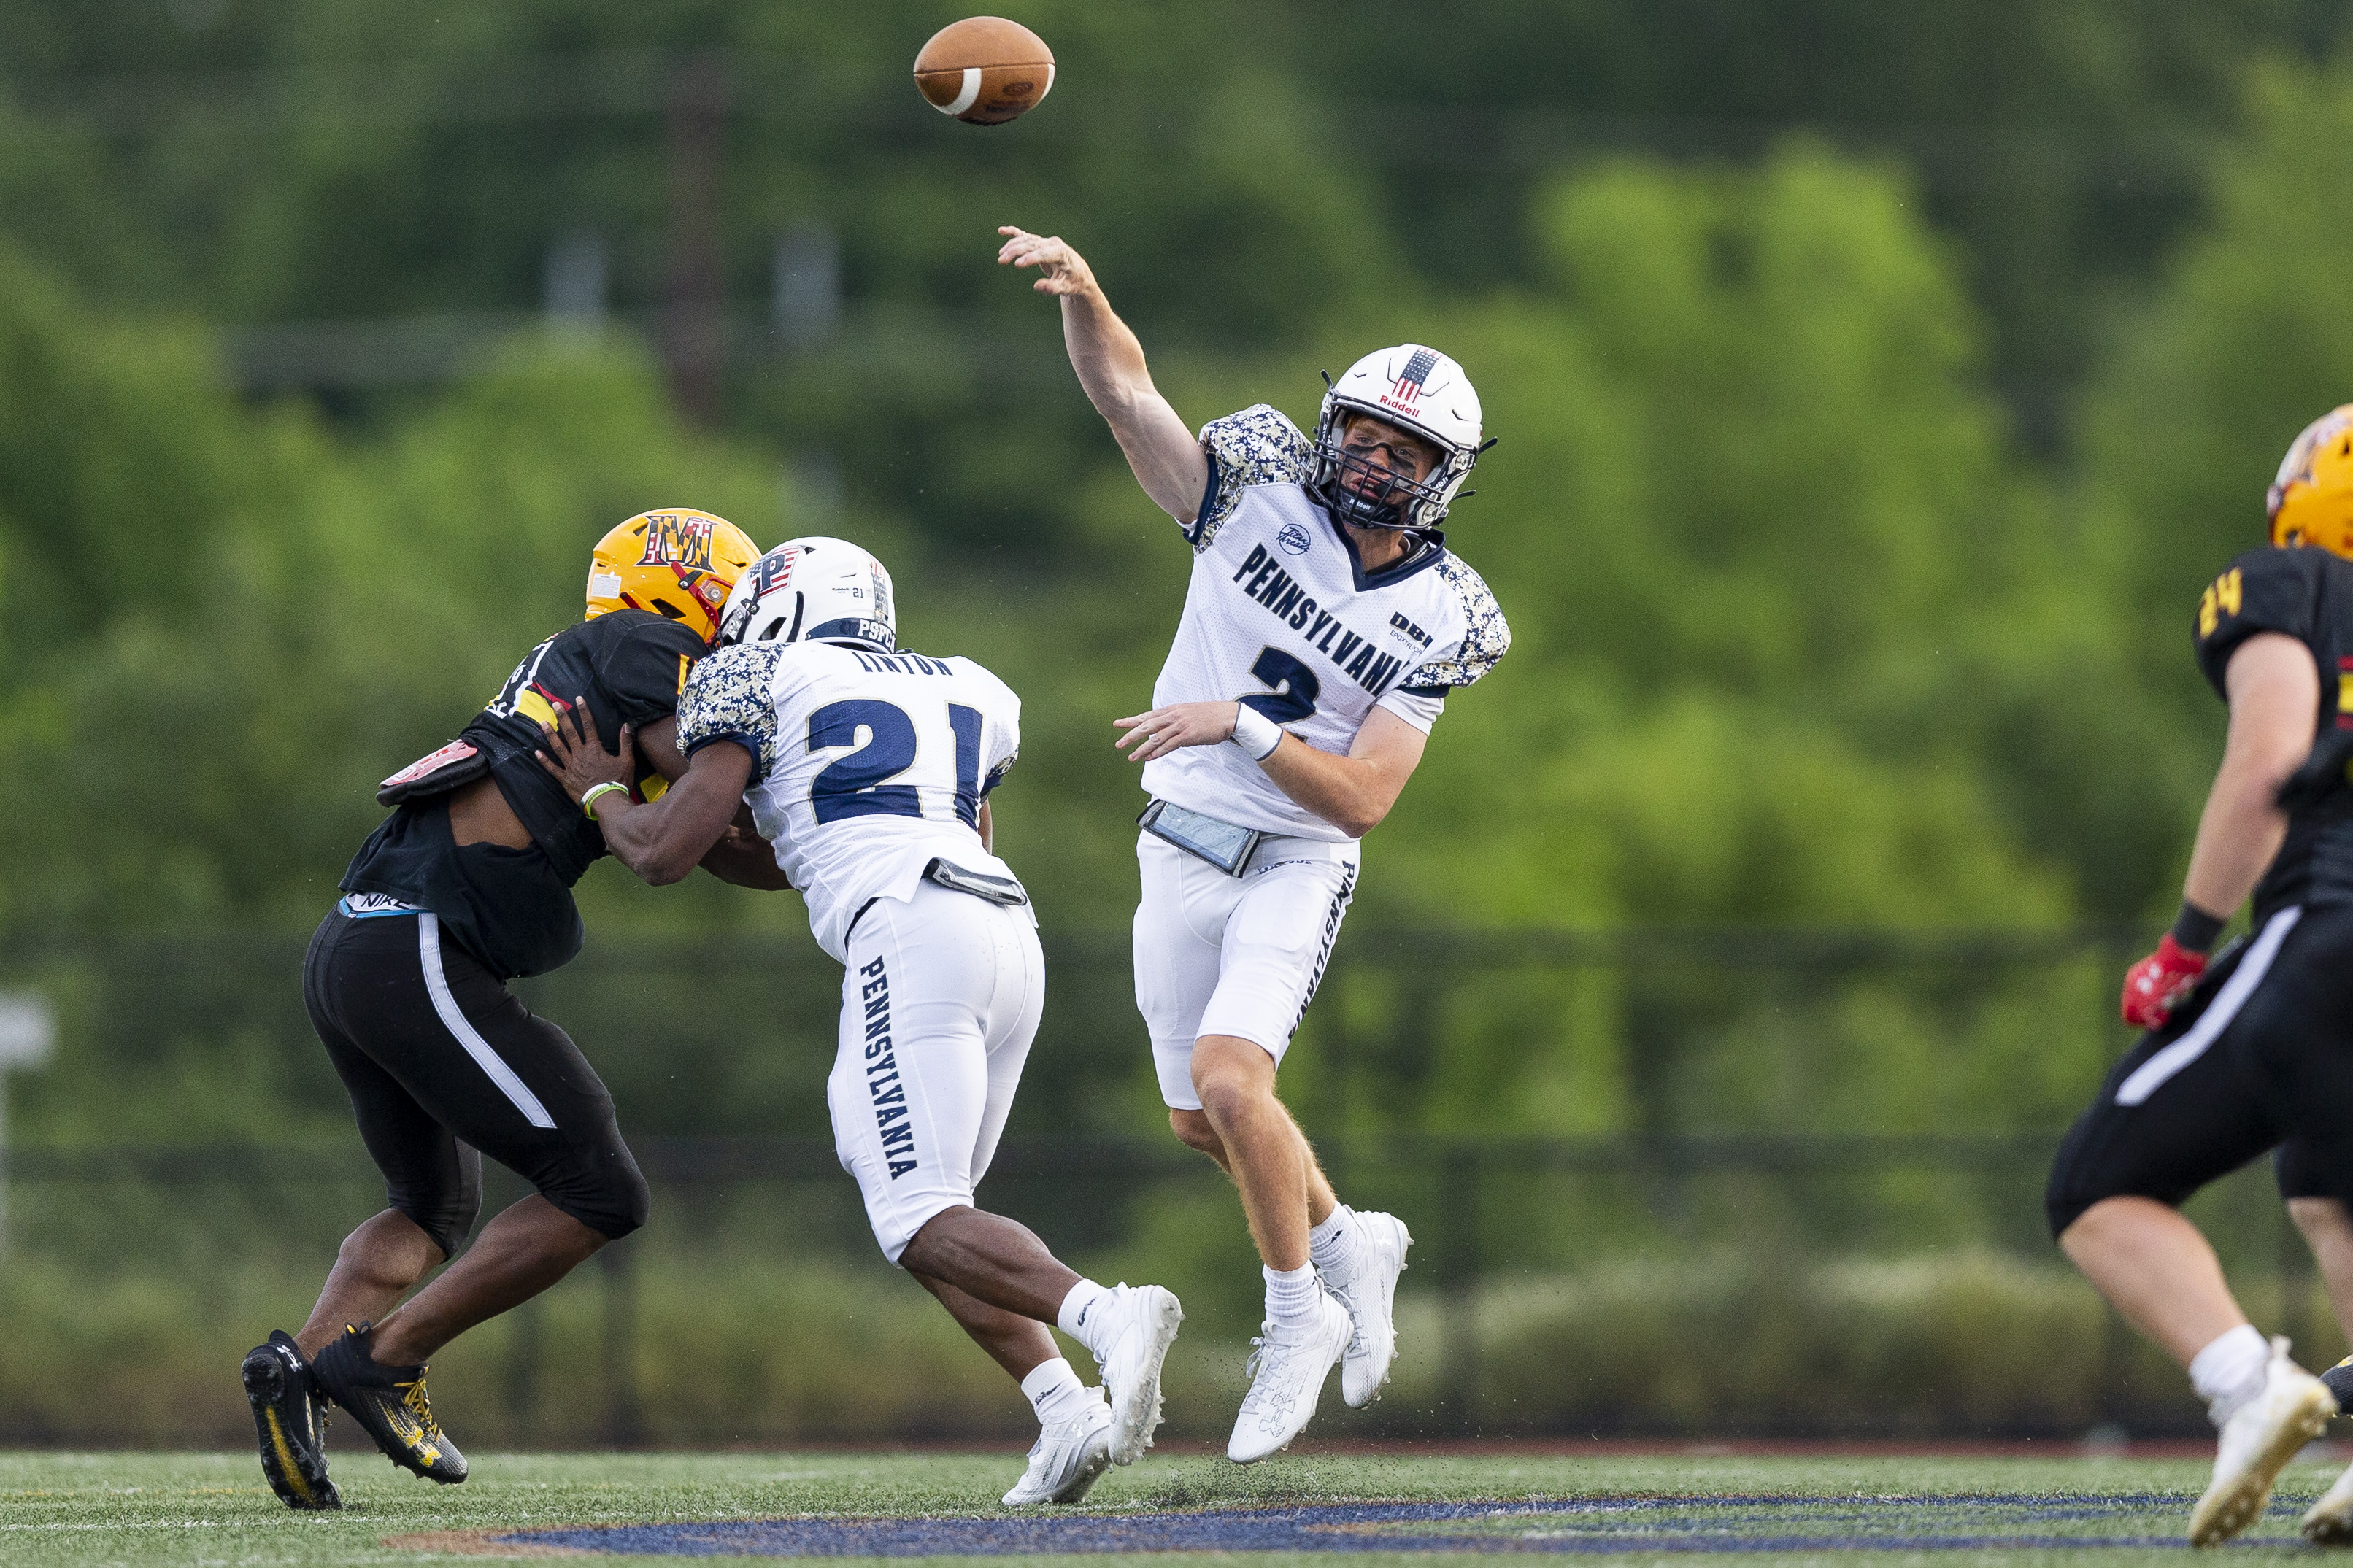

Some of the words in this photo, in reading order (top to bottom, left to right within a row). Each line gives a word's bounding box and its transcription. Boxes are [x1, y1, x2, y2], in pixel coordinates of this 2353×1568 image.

[1379, 395, 1420, 417] Riddell
[634, 514, 719, 575] M
[760, 553, 785, 592] P
[852, 587, 864, 599] 21
[1232, 542, 1411, 698] PENNSYLVANI
[2199, 567, 2243, 638] 24
[851, 651, 954, 676] LINTON
[805, 697, 985, 831] 21
[860, 954, 918, 1181] PENNSYLVANIA
